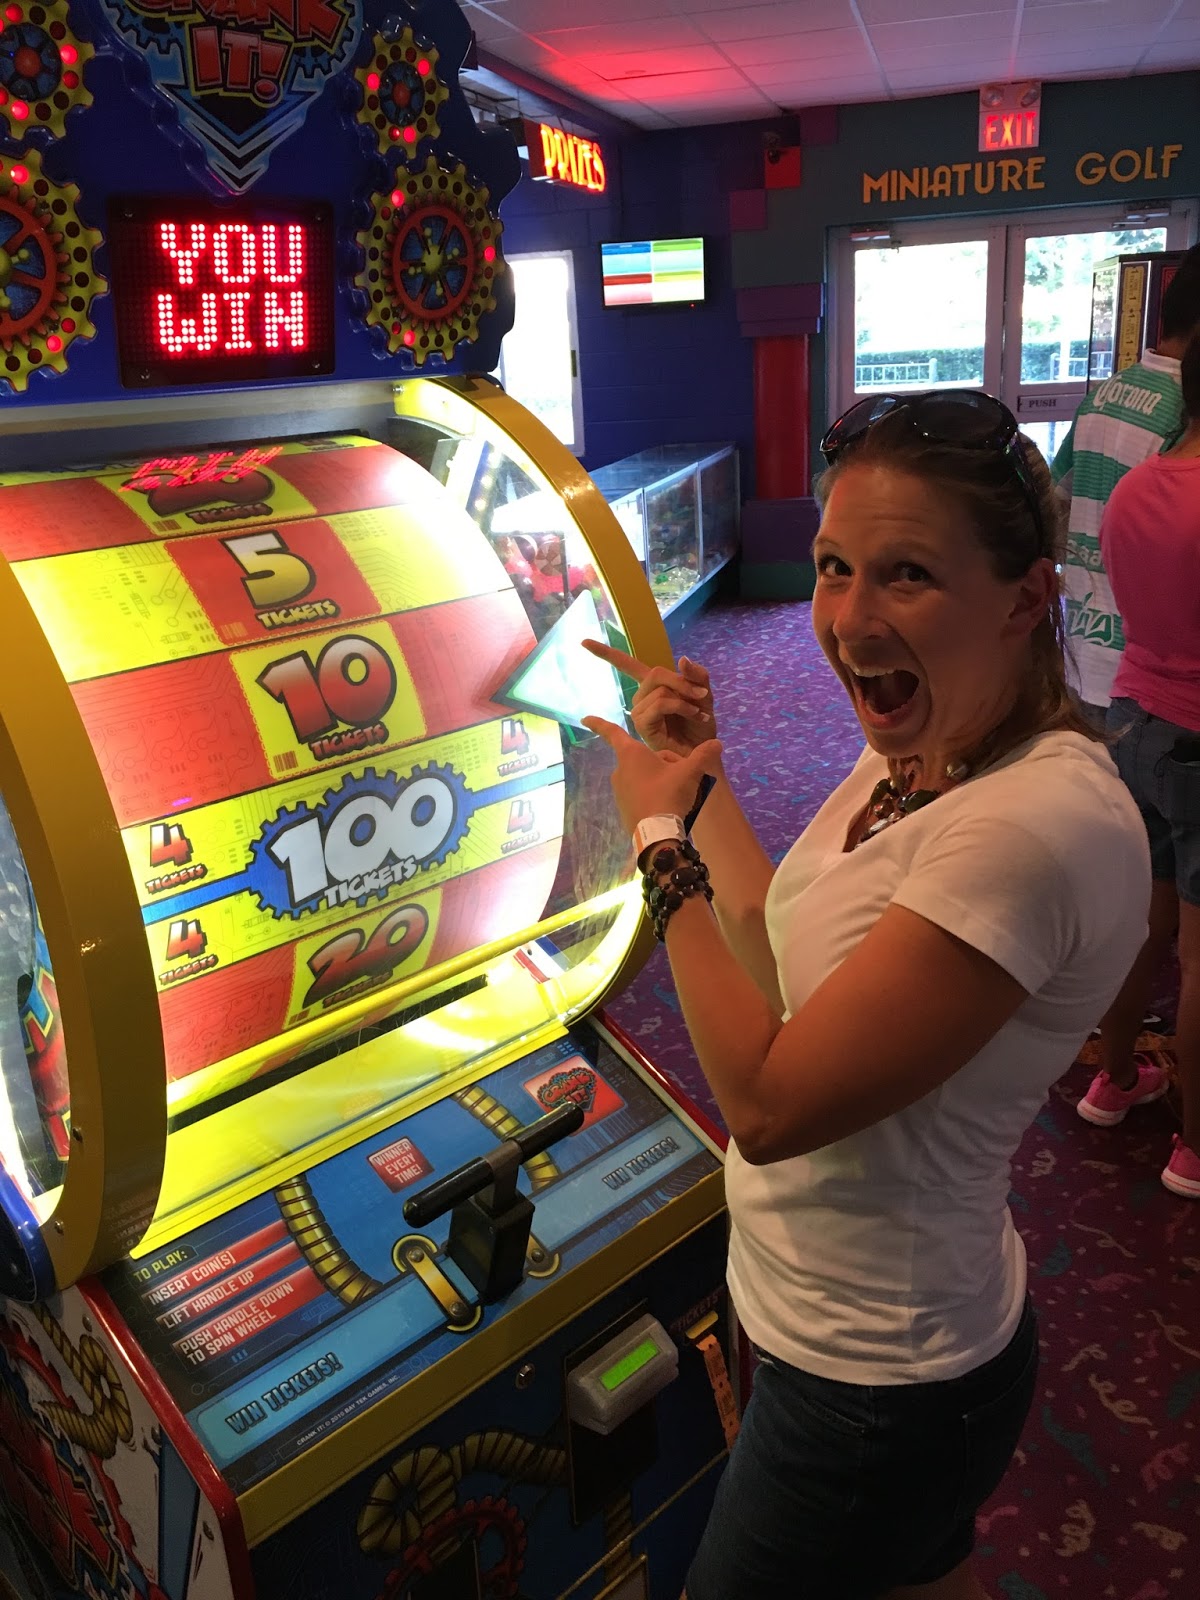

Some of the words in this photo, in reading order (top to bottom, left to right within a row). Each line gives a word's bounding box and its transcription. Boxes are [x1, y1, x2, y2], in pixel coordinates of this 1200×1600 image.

[191, 25, 289, 101] IT!
[984, 110, 1037, 149] EXIT
[540, 122, 606, 192] PRIZES
[863, 156, 1046, 204] MINIATURE
[1075, 143, 1183, 186] GOLF
[158, 222, 303, 285] YOU
[157, 291, 304, 352] WIN
[1029, 399, 1057, 408] PUSH
[1093, 374, 1162, 415] Corona
[185, 502, 274, 524] TICKETS
[218, 529, 317, 609] 5
[256, 599, 341, 630] TICKETS
[255, 634, 397, 744] 10
[308, 721, 389, 761] TICKETS
[501, 718, 529, 755] 4
[497, 754, 539, 777] TICKETS
[507, 800, 534, 833] 4
[150, 823, 194, 867] 4
[267, 773, 457, 906] 100
[501, 831, 540, 854] TICKETS
[145, 863, 208, 895] TICKETS
[323, 855, 418, 908] TICKETS
[166, 919, 208, 961] 4
[302, 903, 429, 1008] 20
[159, 954, 219, 985] TICKETS
[373, 1141, 412, 1166] WINNER
[385, 1153, 416, 1175] EVERY
[394, 1164, 423, 1183] TIME!
[602, 1167, 632, 1190] WIN
[624, 1136, 680, 1176] TICKETS!
[133, 1270, 151, 1283] TO
[152, 1250, 188, 1274] PLAY:
[149, 1277, 191, 1305] INSERT
[163, 1307, 191, 1328] LIFT
[192, 1281, 239, 1312] HANDLE
[240, 1271, 255, 1286] UP
[179, 1329, 214, 1354] PUSH
[213, 1305, 259, 1335] HANDLE
[259, 1282, 294, 1308] DOWN
[187, 1350, 206, 1365] TO
[205, 1334, 236, 1356] SPIN
[234, 1310, 276, 1338] WHEEL
[225, 1400, 267, 1434] WIN
[261, 1352, 344, 1412] TICKETS!
[296, 1430, 317, 1446] CRANK
[344, 1403, 356, 1414] BAY
[356, 1396, 368, 1406] TEK
